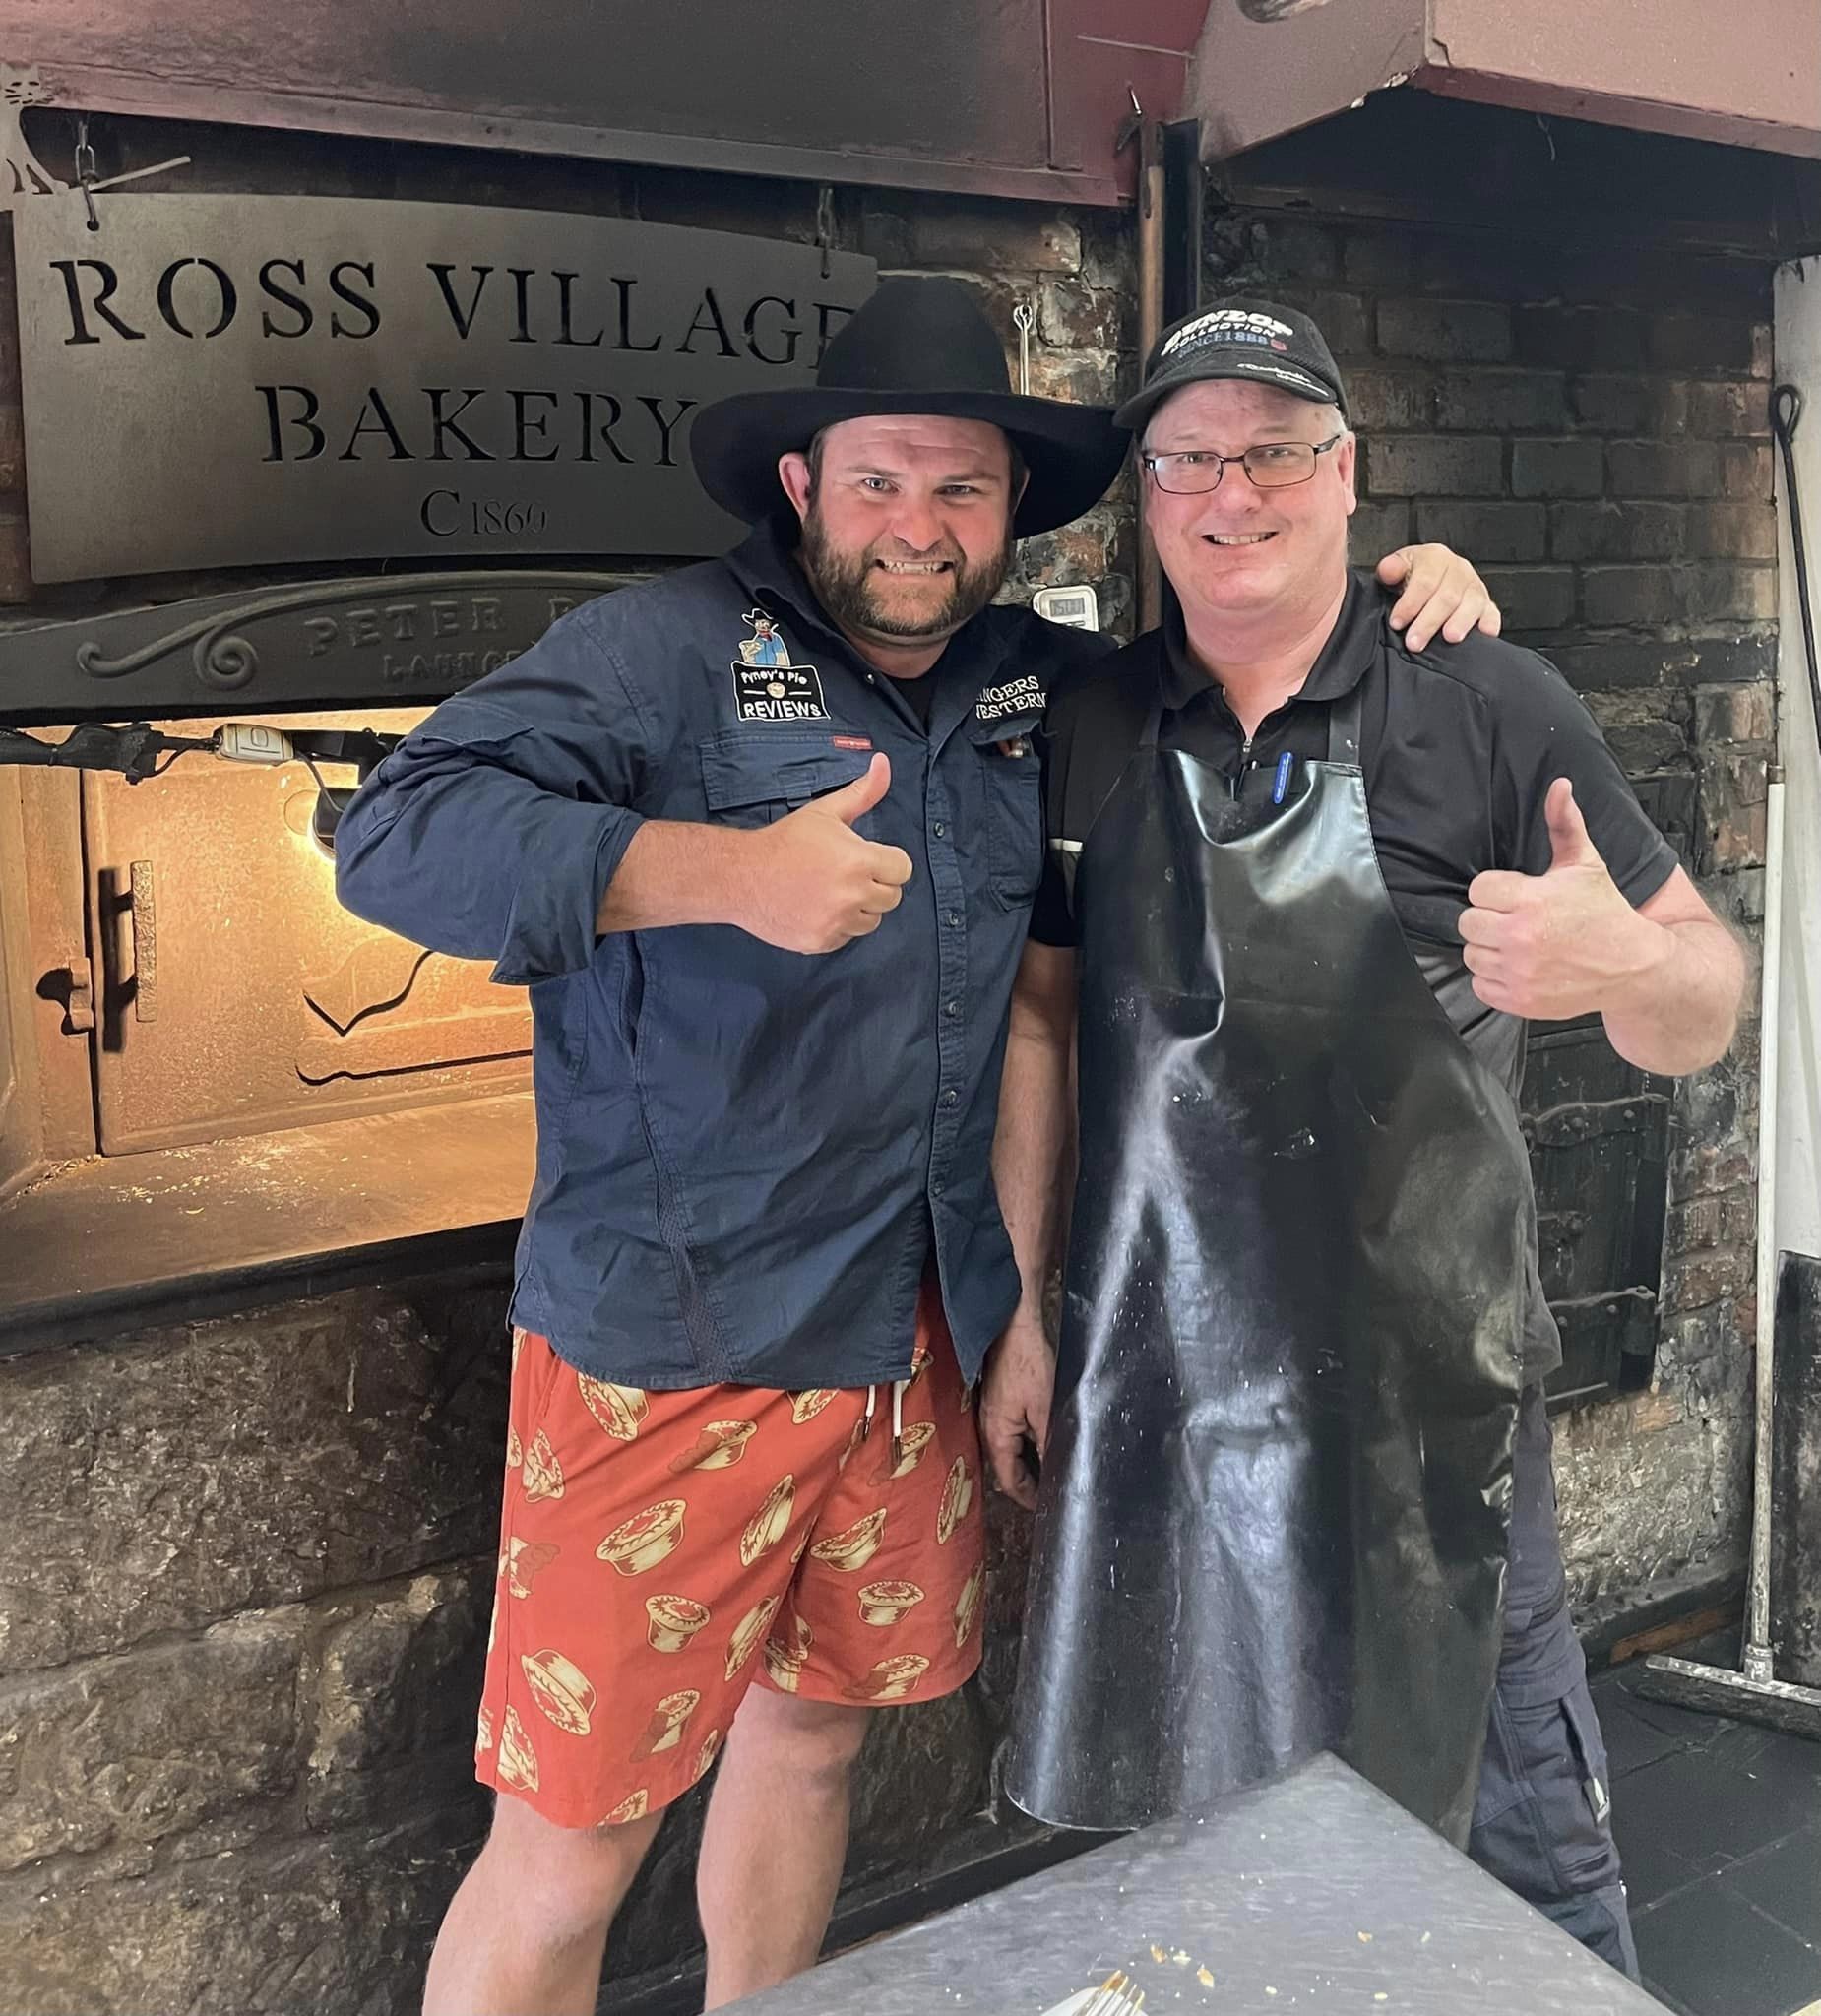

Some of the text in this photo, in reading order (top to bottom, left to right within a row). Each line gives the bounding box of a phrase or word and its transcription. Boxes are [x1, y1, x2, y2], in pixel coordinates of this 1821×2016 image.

[49, 258, 382, 346] ROSS
[1161, 309, 1294, 357] DUNLOP
[1169, 321, 1277, 355] COLLECTION
[254, 384, 698, 468] BAKERY
[471, 500, 546, 536] 1860
[303, 596, 506, 657] PETER
[743, 700, 822, 719] REVIEWS
